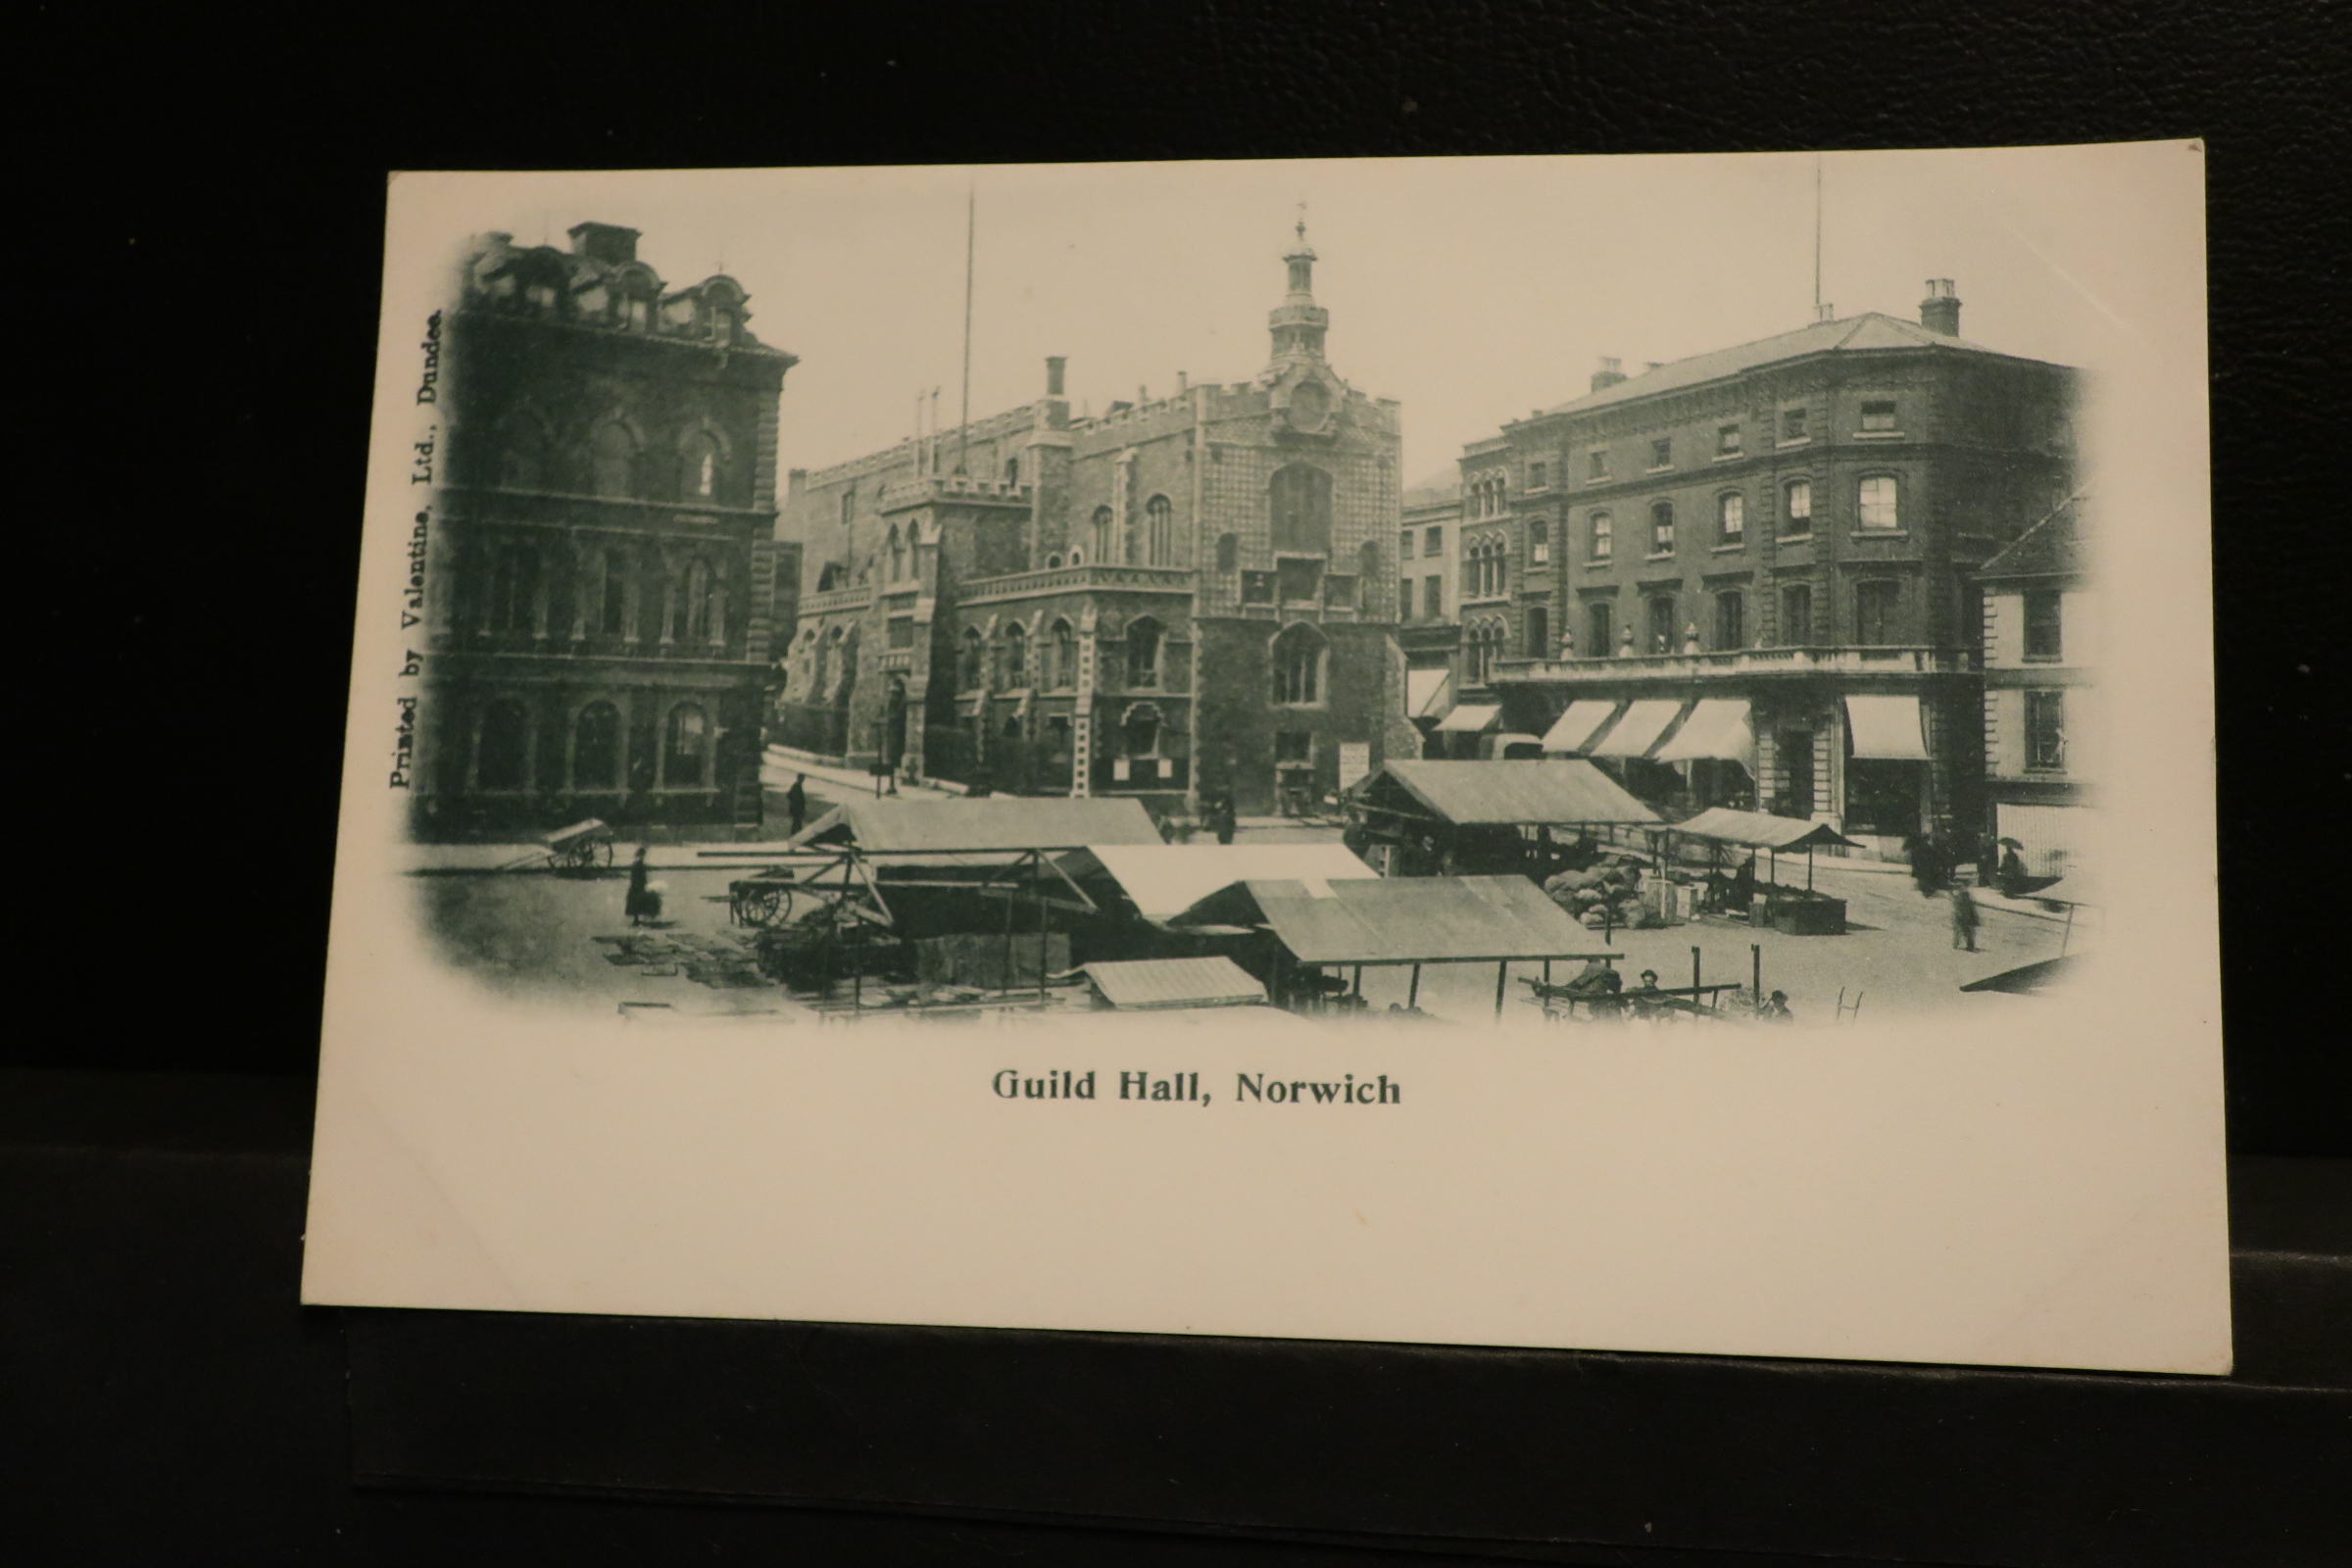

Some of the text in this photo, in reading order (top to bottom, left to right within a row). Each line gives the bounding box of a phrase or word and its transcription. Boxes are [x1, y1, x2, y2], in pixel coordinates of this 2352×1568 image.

[412, 424, 437, 485] Ltd.,
[401, 504, 432, 630] Valentine,
[398, 649, 423, 677] by
[390, 696, 417, 789] Printed
[993, 1069, 1401, 1107] Guild Hall, Norwich
